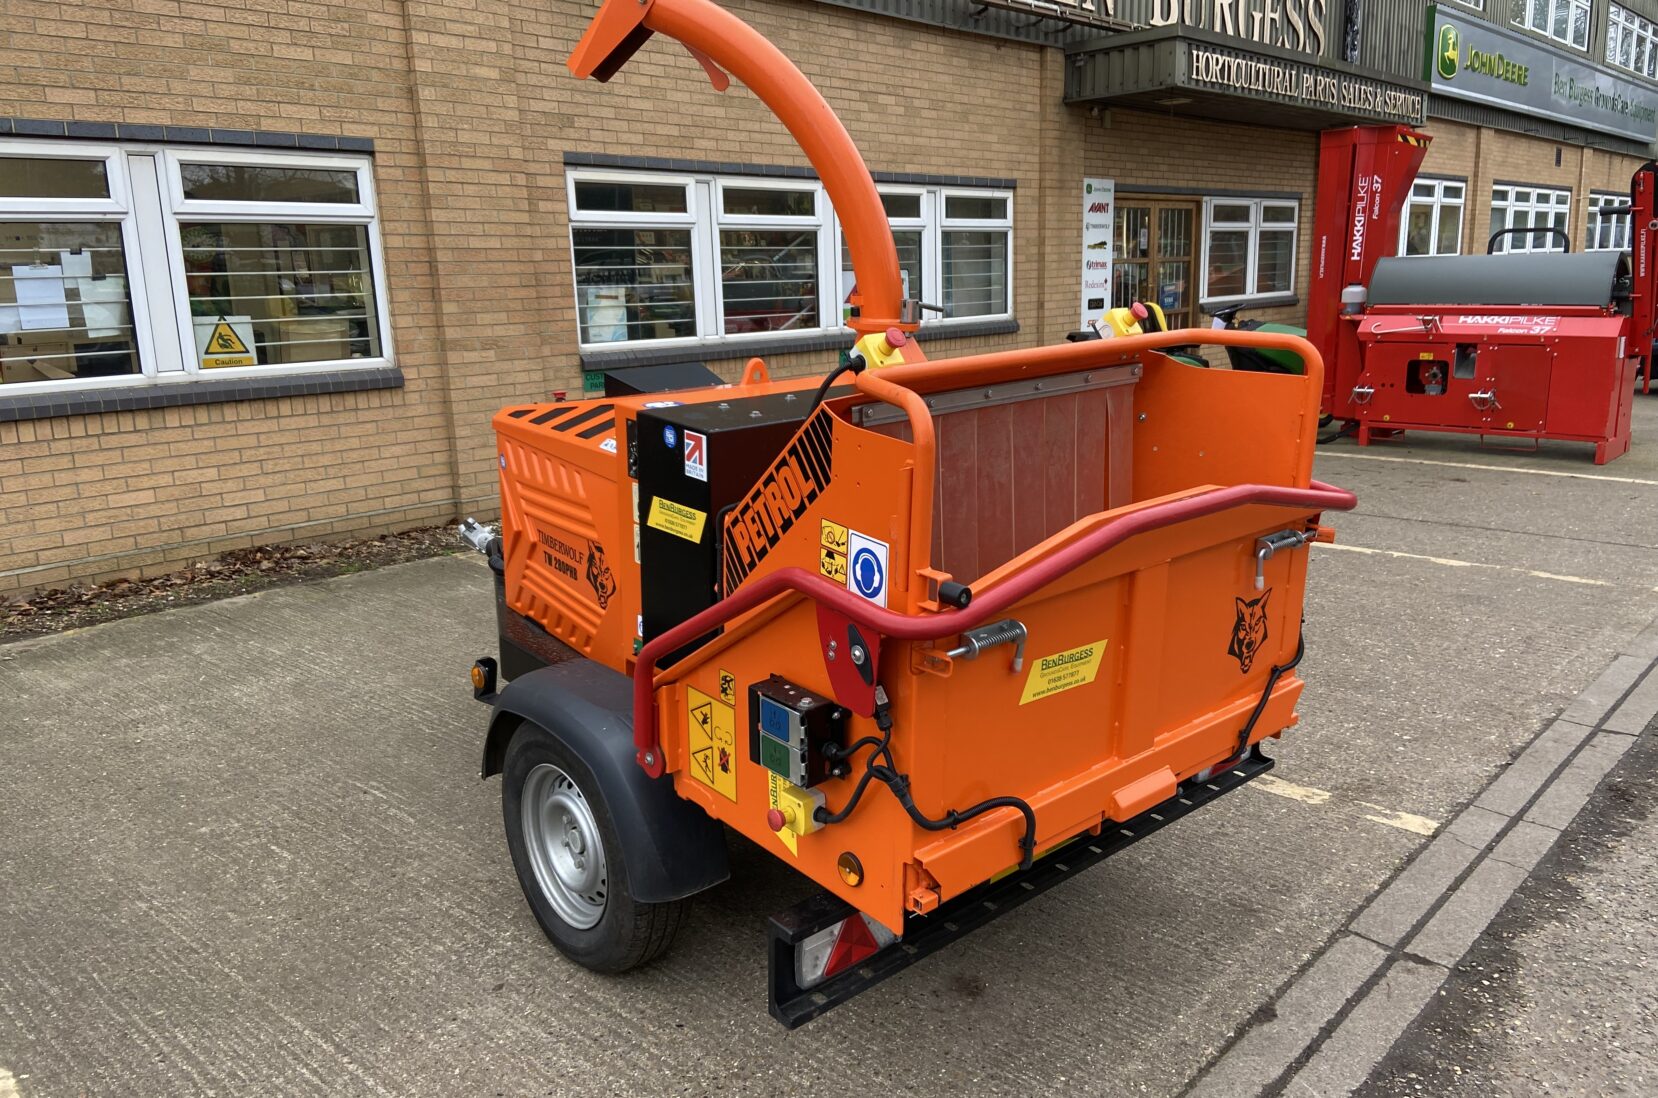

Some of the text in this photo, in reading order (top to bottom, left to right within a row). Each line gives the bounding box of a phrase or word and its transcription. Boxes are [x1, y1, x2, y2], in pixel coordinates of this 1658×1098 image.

[1191, 50, 1299, 97] HORTICULTURAL
[1341, 82, 1374, 111] SALES
[1375, 89, 1383, 112] &
[1384, 90, 1421, 118] SERVICE
[1553, 72, 1568, 98] Ben
[1568, 76, 1594, 107] Burgess
[1088, 203, 1110, 214] AVANT
[1372, 174, 1382, 220] Falcon 37
[1350, 175, 1369, 261] HAKKIPILKE
[1458, 315, 1557, 325] HAKKIPILKE
[1529, 326, 1552, 334] 37
[585, 372, 604, 381] CUST
[733, 455, 816, 564] PETROL
[537, 528, 585, 566] TIMBERWOLF
[543, 550, 553, 567] TW
